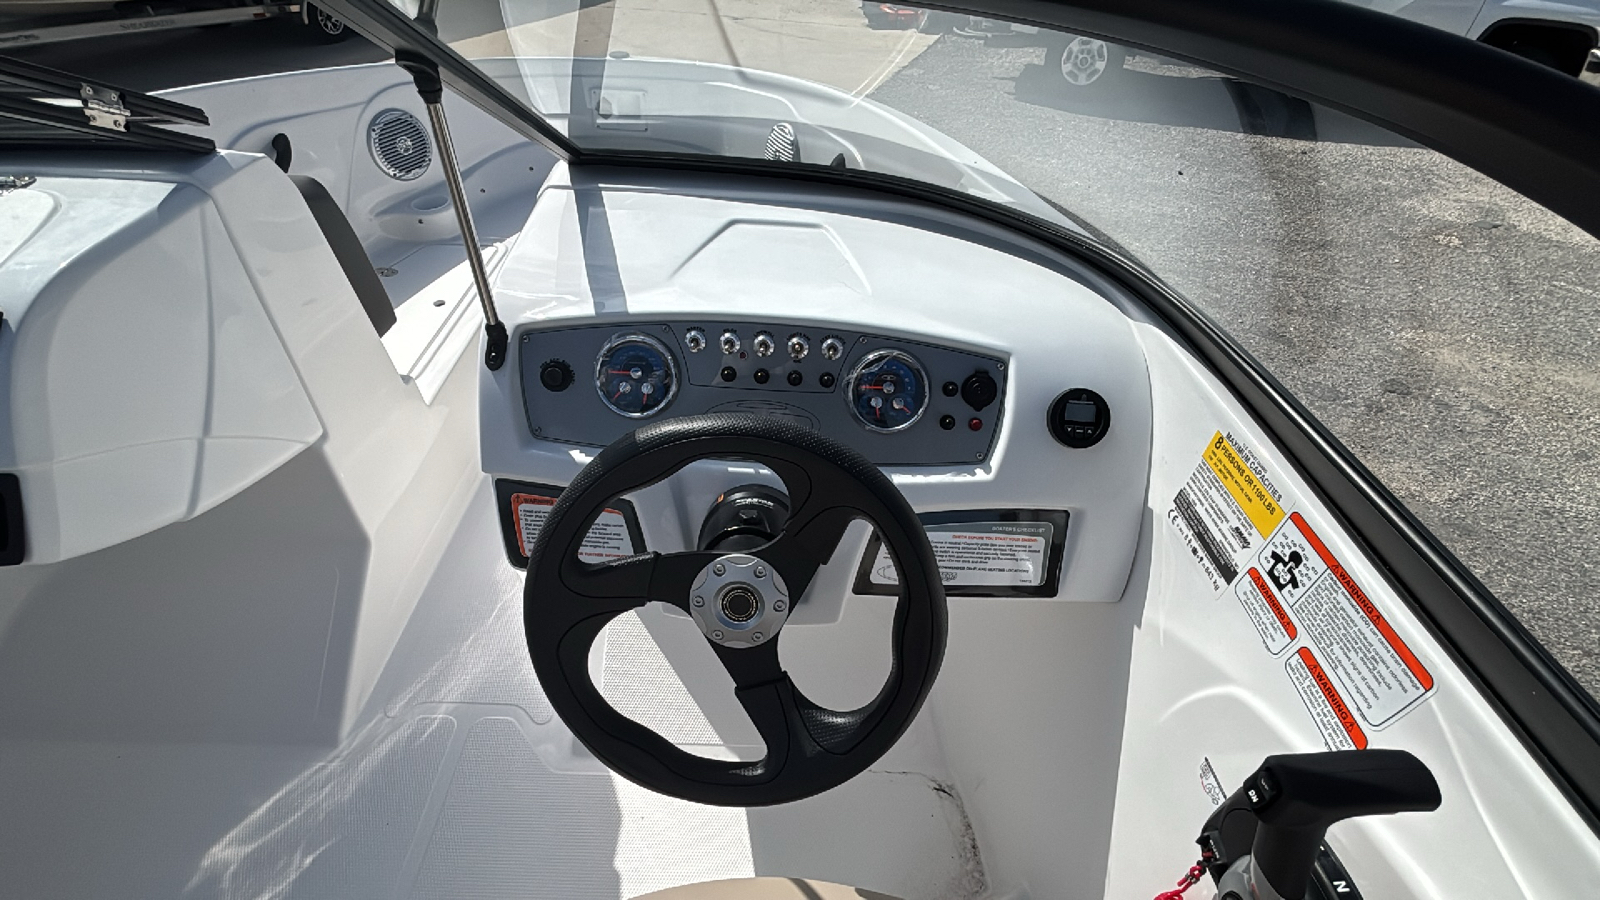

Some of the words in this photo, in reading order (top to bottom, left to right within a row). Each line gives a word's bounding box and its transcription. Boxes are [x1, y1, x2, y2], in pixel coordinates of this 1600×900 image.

[1213, 435, 1225, 450] 8
[1220, 444, 1246, 477] PERSONS
[1242, 473, 1254, 488] OR
[1262, 497, 1276, 515] LBS
[1224, 431, 1251, 464] MAXIMUM
[1248, 460, 1283, 502] CAPACITIES
[1258, 582, 1286, 620] WARNING
[1338, 570, 1374, 615] WARNING
[1314, 671, 1349, 721] WARNING
[1399, 666, 1420, 692] damage
[1248, 789, 1259, 803] DN
[1332, 880, 1350, 893] N
